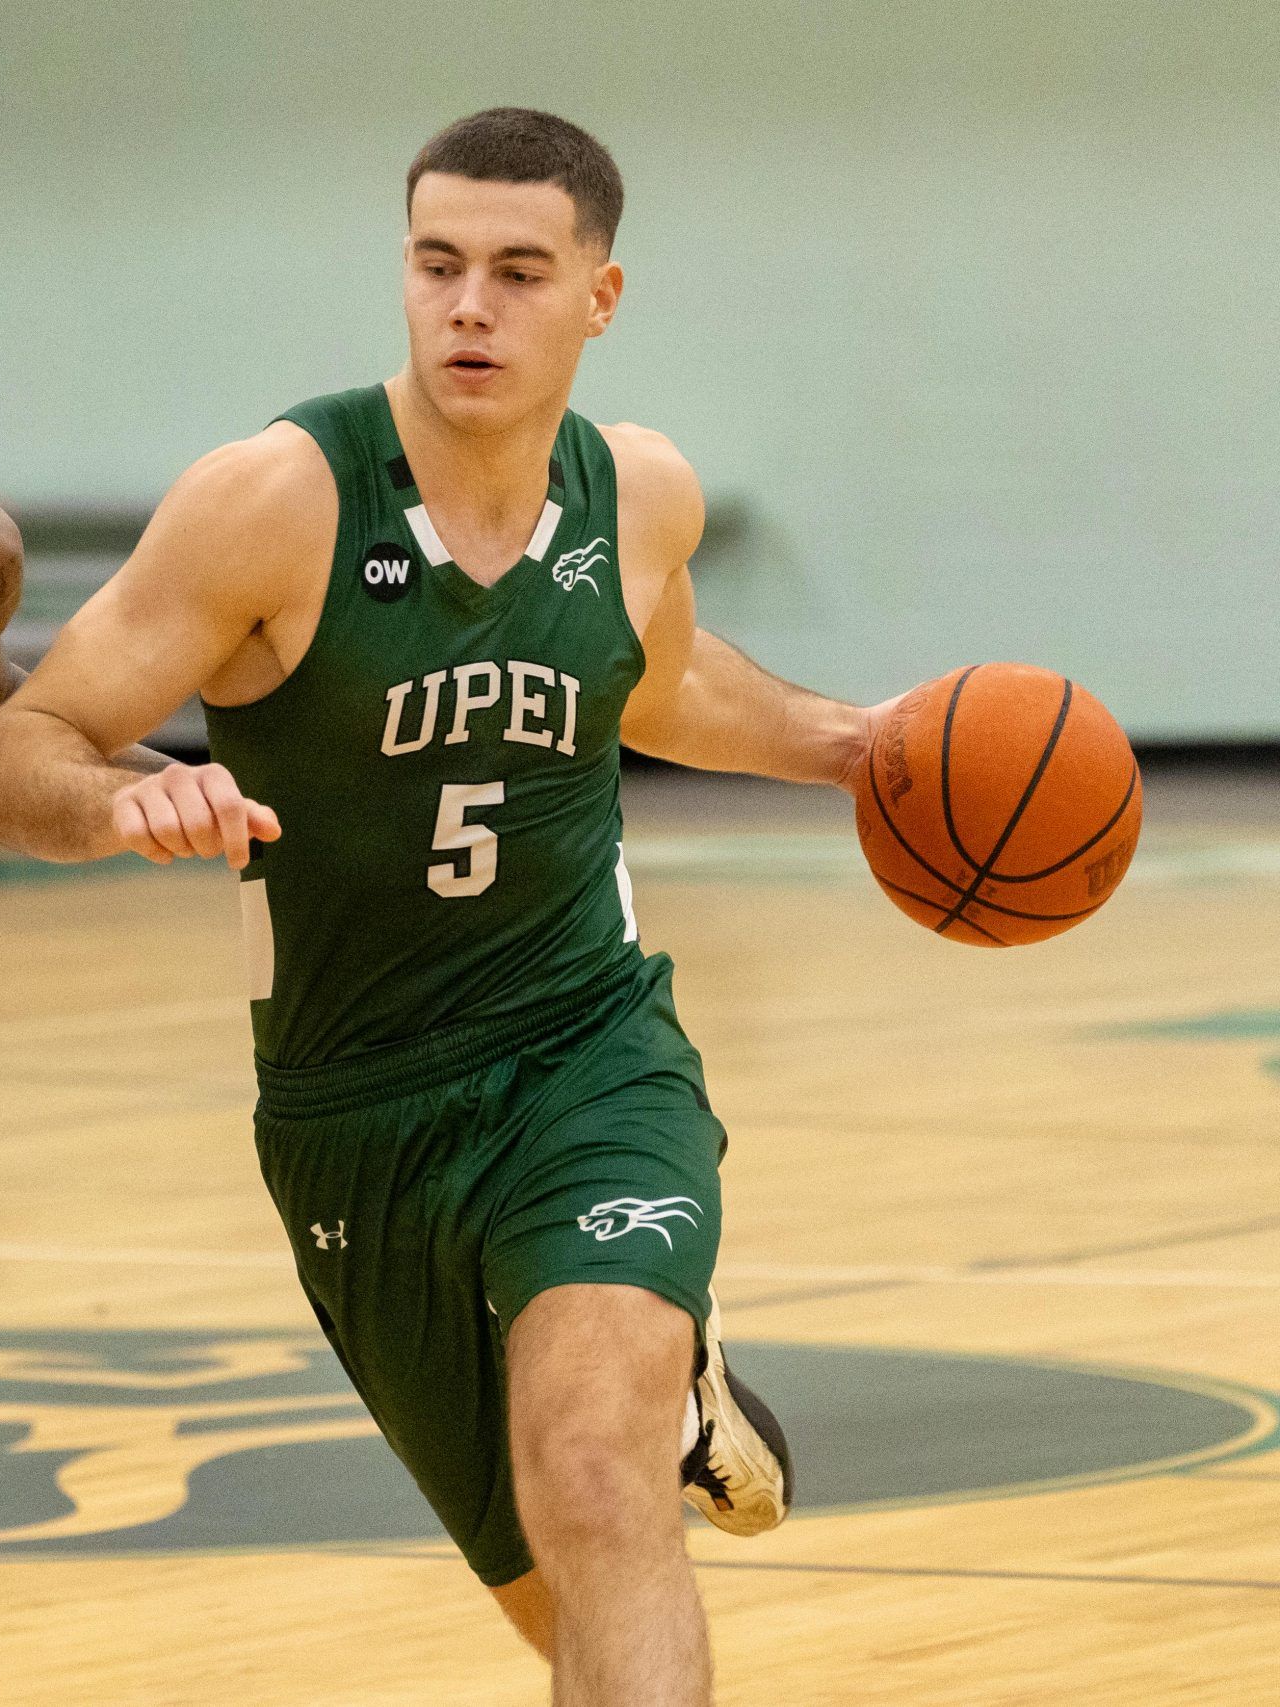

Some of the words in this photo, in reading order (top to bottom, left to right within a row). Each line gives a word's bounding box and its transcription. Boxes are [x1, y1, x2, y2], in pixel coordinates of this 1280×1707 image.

[363, 559, 411, 585] OW
[380, 660, 582, 757] UPEI
[427, 780, 506, 898] 5
